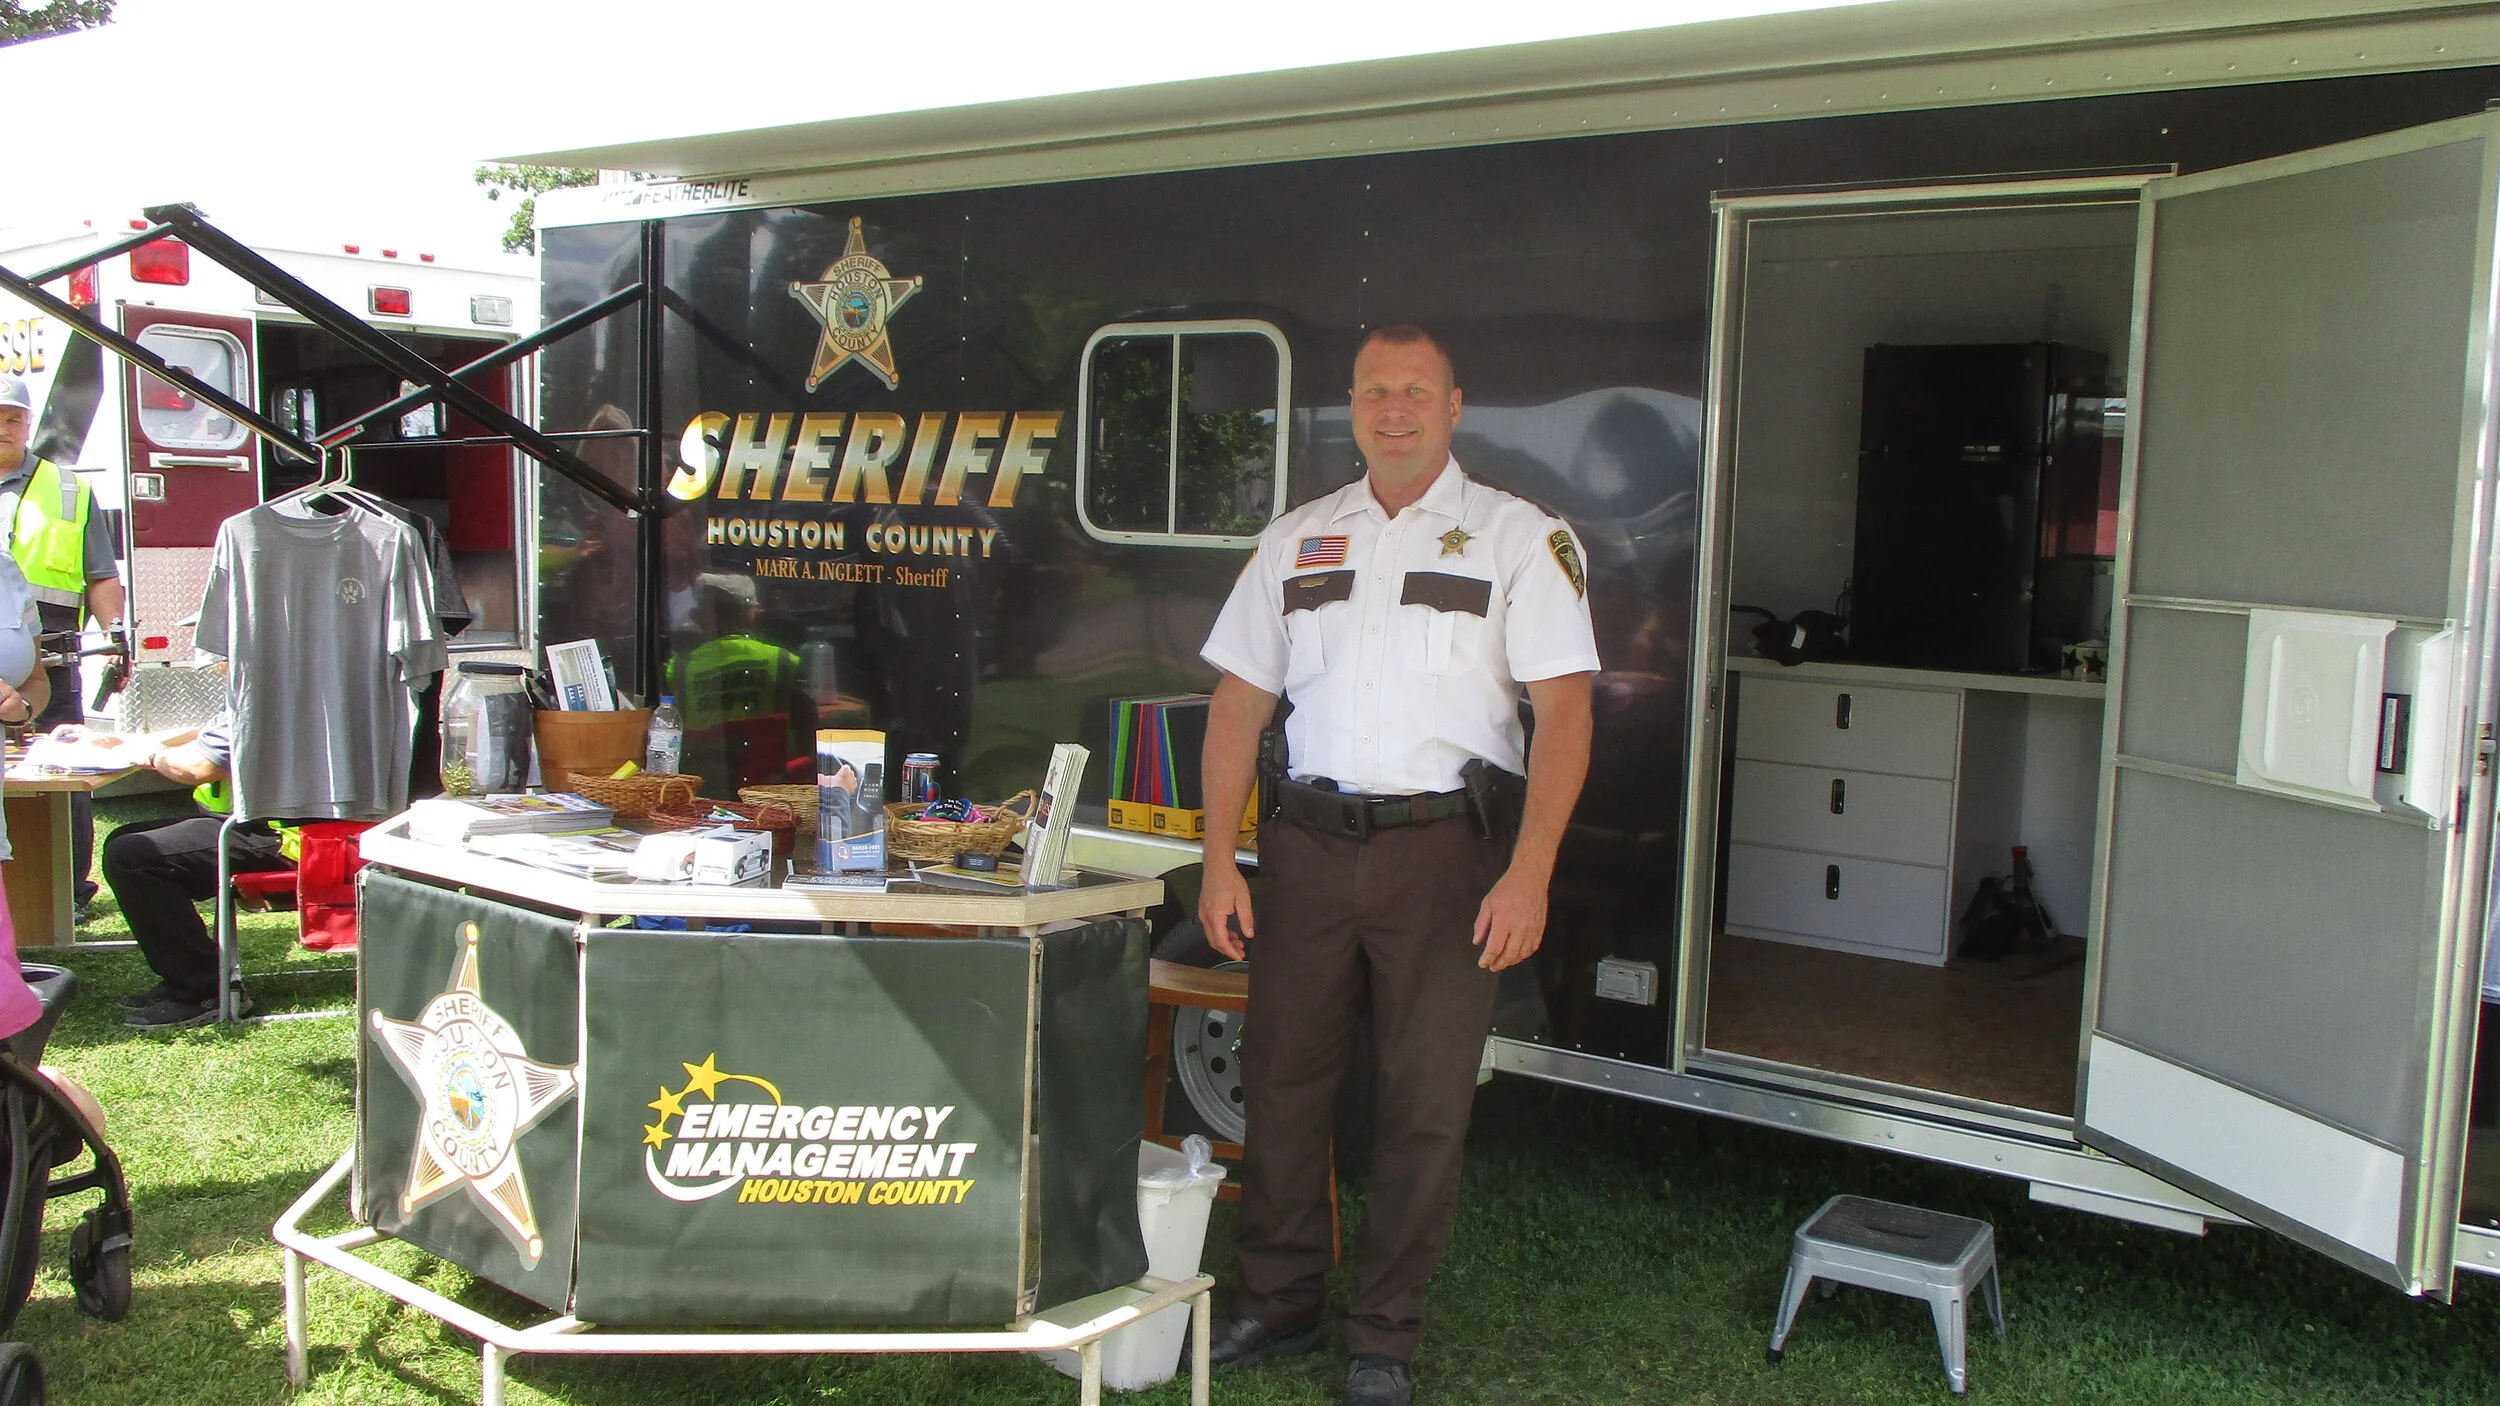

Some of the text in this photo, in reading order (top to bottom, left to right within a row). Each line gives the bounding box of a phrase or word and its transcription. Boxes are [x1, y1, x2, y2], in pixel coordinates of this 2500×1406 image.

[641, 178, 750, 204] FEATHERLITE
[833, 257, 883, 277] SHERIFF
[830, 271, 883, 301] HOUSTON
[832, 324, 878, 349] COUNTY
[666, 410, 1065, 508] SHERIFF
[706, 517, 997, 558] HOUSTON COUNTY
[756, 558, 798, 579] MARK
[801, 561, 815, 580] A.
[817, 560, 884, 584] INGLETT
[895, 565, 950, 588] Sheriff
[434, 998, 511, 1039] SHERIFF
[676, 1103, 956, 1141] EMERGENCY
[432, 1119, 502, 1174] COUNTY
[664, 1142, 978, 1179] MANAGEMENT
[737, 1178, 976, 1206] HOUSTON COUNTY
